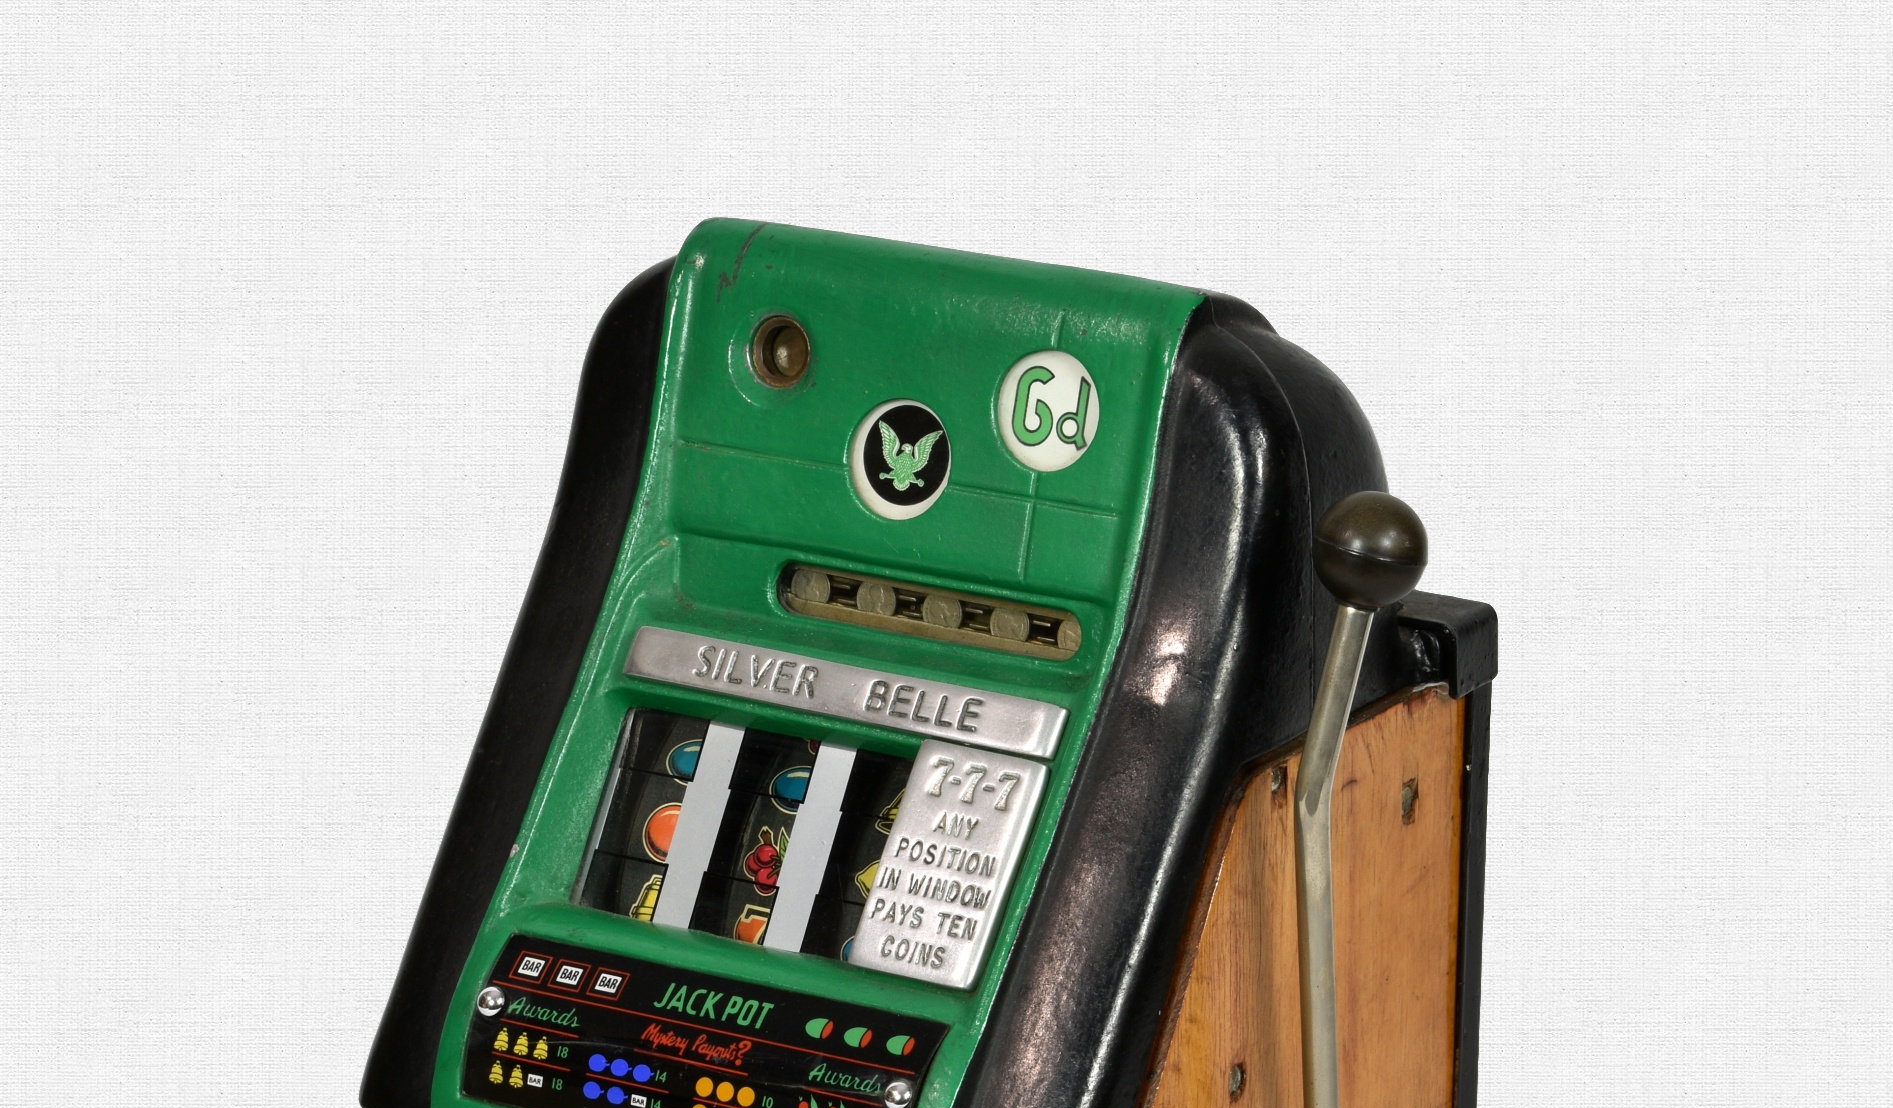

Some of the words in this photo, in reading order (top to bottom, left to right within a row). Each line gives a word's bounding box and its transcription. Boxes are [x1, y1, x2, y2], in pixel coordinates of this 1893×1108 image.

[691, 644, 819, 700] SILVER
[861, 679, 985, 734] BELLE
[927, 757, 1021, 811] 7-7-7
[933, 811, 980, 840] ANY
[894, 837, 997, 877] POSITION
[877, 866, 902, 891] IN
[907, 872, 992, 910] WINDOW
[870, 898, 925, 930] PAYS
[936, 911, 979, 942] TEN
[880, 934, 946, 969] COINS
[521, 957, 543, 974] BAR
[559, 966, 581, 982] BAR
[598, 974, 620, 991] BAR
[507, 996, 580, 1028] Awards
[653, 982, 724, 1019] JACK
[721, 995, 775, 1029] POT
[557, 1045, 569, 1059] 18
[641, 1022, 689, 1056] Mystery
[528, 1075, 543, 1086] BAR
[552, 1077, 563, 1091] 18
[655, 1069, 668, 1083] 14
[808, 1063, 883, 1094] Awards
[632, 1095, 646, 1106] BAR
[761, 1095, 774, 1108] 10
